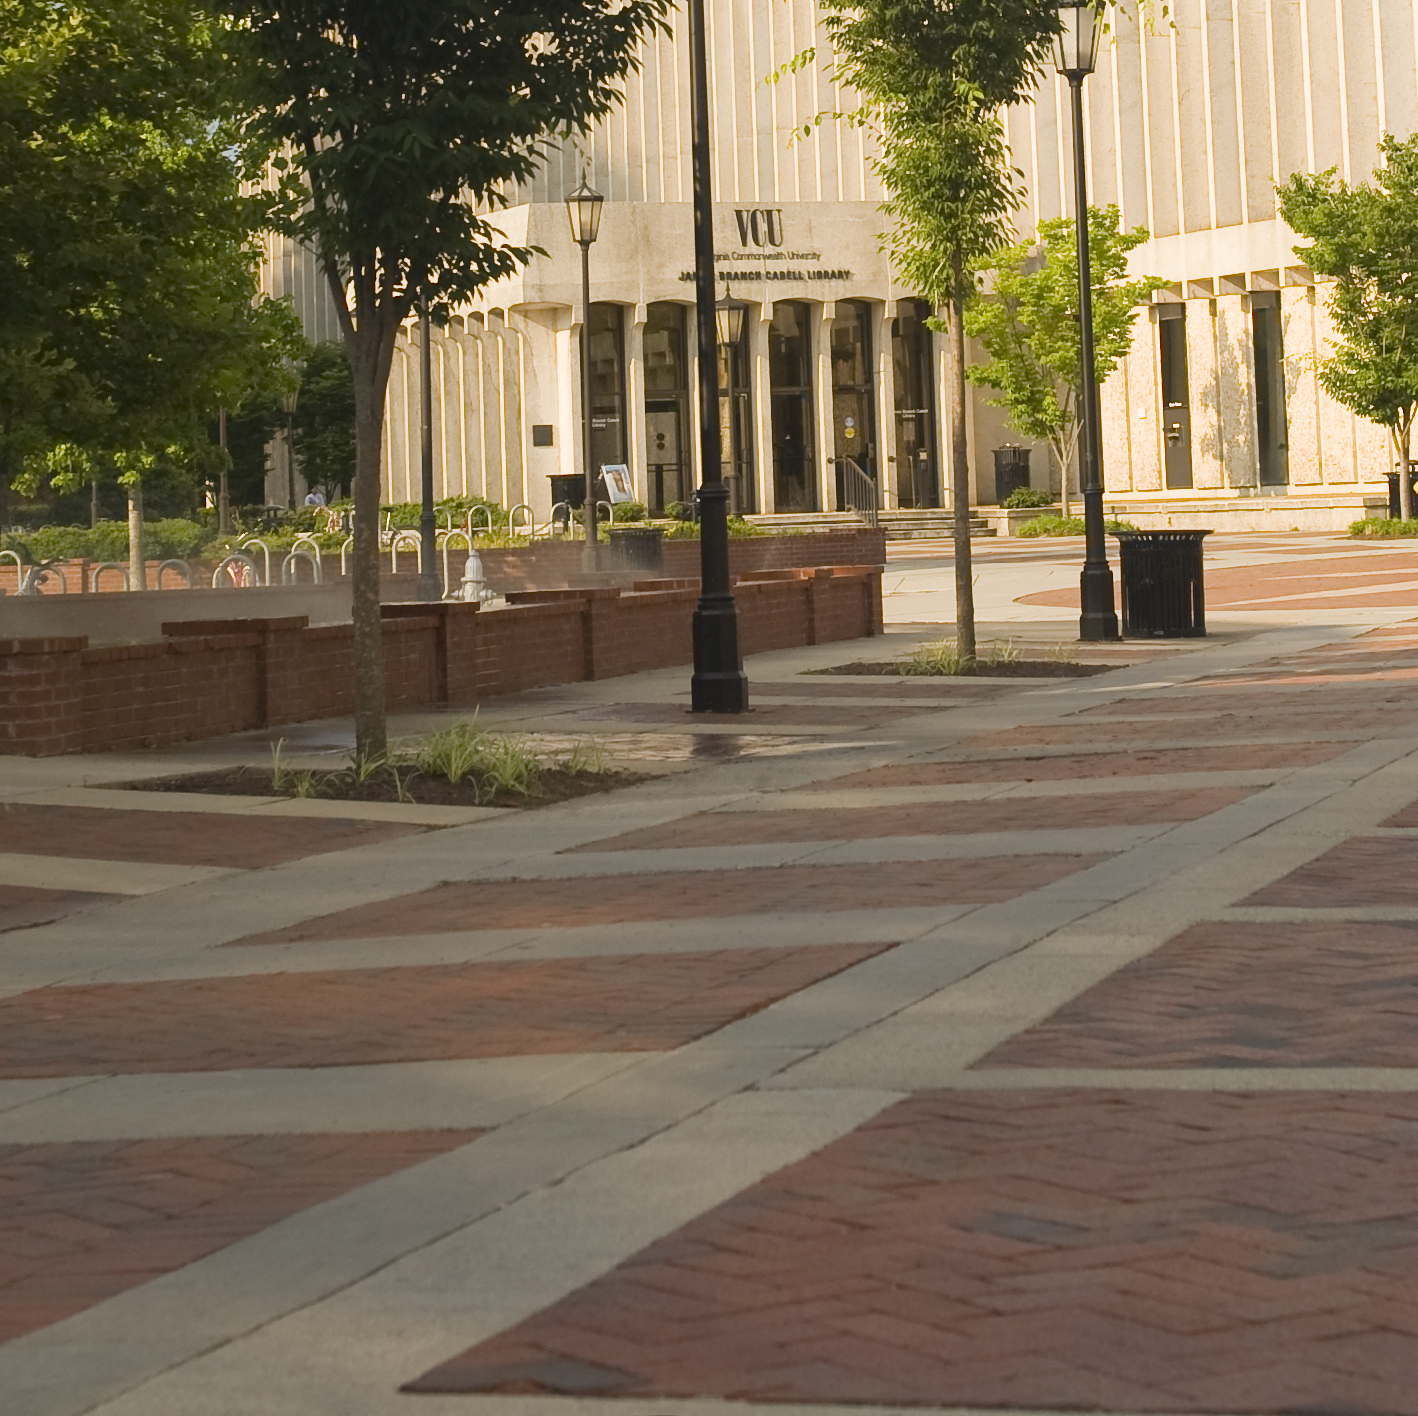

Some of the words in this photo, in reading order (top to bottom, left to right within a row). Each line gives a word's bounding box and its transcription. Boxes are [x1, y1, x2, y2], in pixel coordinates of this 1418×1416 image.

[734, 208, 783, 248] VCU
[718, 270, 762, 281] BRANCH
[765, 270, 804, 281] CABELL
[807, 269, 851, 281] LIBRARY
